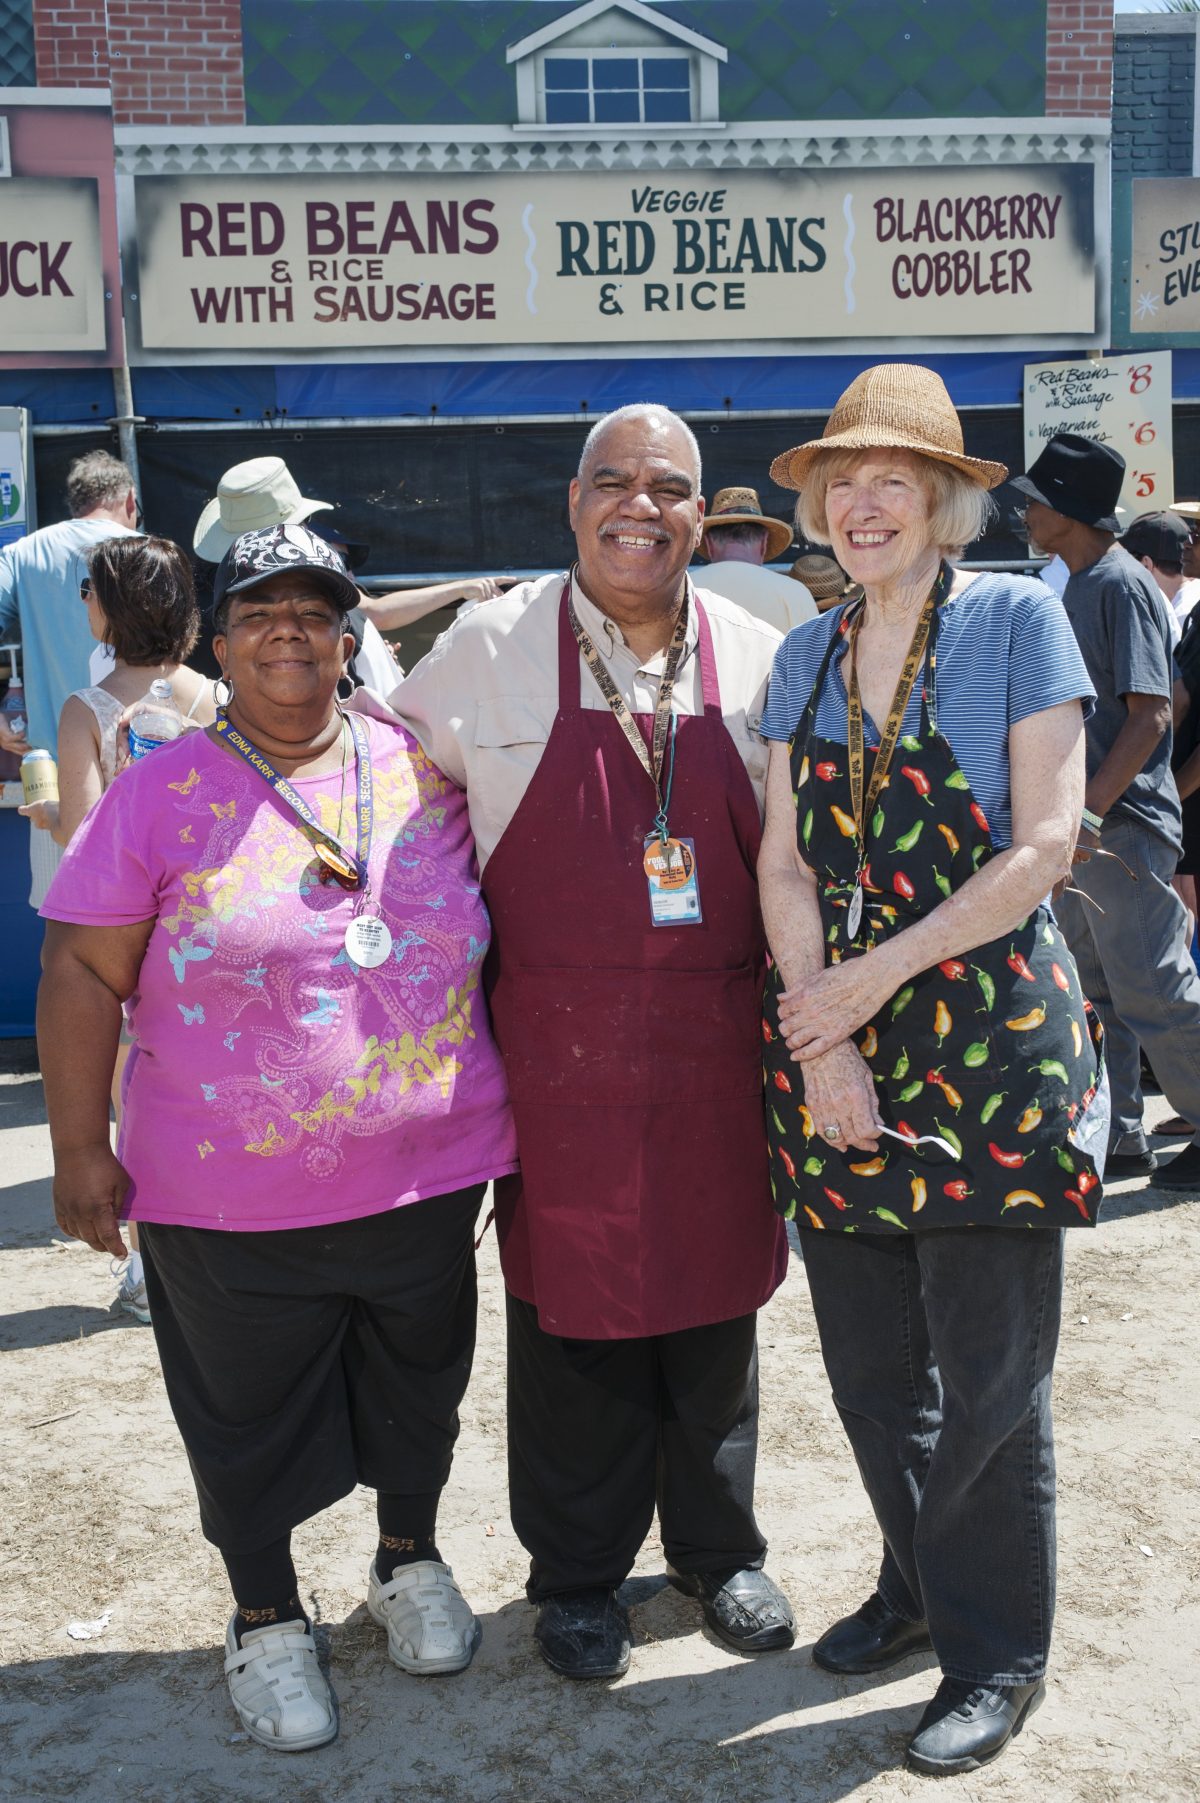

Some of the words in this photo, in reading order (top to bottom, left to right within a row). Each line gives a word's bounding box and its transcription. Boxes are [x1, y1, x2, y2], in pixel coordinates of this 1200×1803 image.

[631, 186, 727, 213] VEGGIE
[180, 202, 285, 257] RED
[305, 199, 499, 255] BEANS
[873, 193, 1062, 243] BLACKBERRY
[556, 220, 656, 276] RED
[672, 217, 826, 274] BEANS
[271, 259, 293, 283] &
[308, 259, 384, 281] RICE
[892, 249, 1032, 299] COBBLER
[190, 286, 294, 323] WITH
[313, 283, 496, 322] SAUSAGE
[599, 283, 624, 315] &
[644, 281, 746, 311] RICE
[1035, 369, 1065, 386] Red
[1066, 367, 1118, 383] Beans
[1061, 381, 1093, 396] Rice
[1061, 391, 1114, 411] Sausage
[1038, 417, 1100, 442] Vegetarian
[227, 731, 252, 755] EDNA
[248, 753, 275, 778] KARR
[361, 807, 371, 834] KARR
